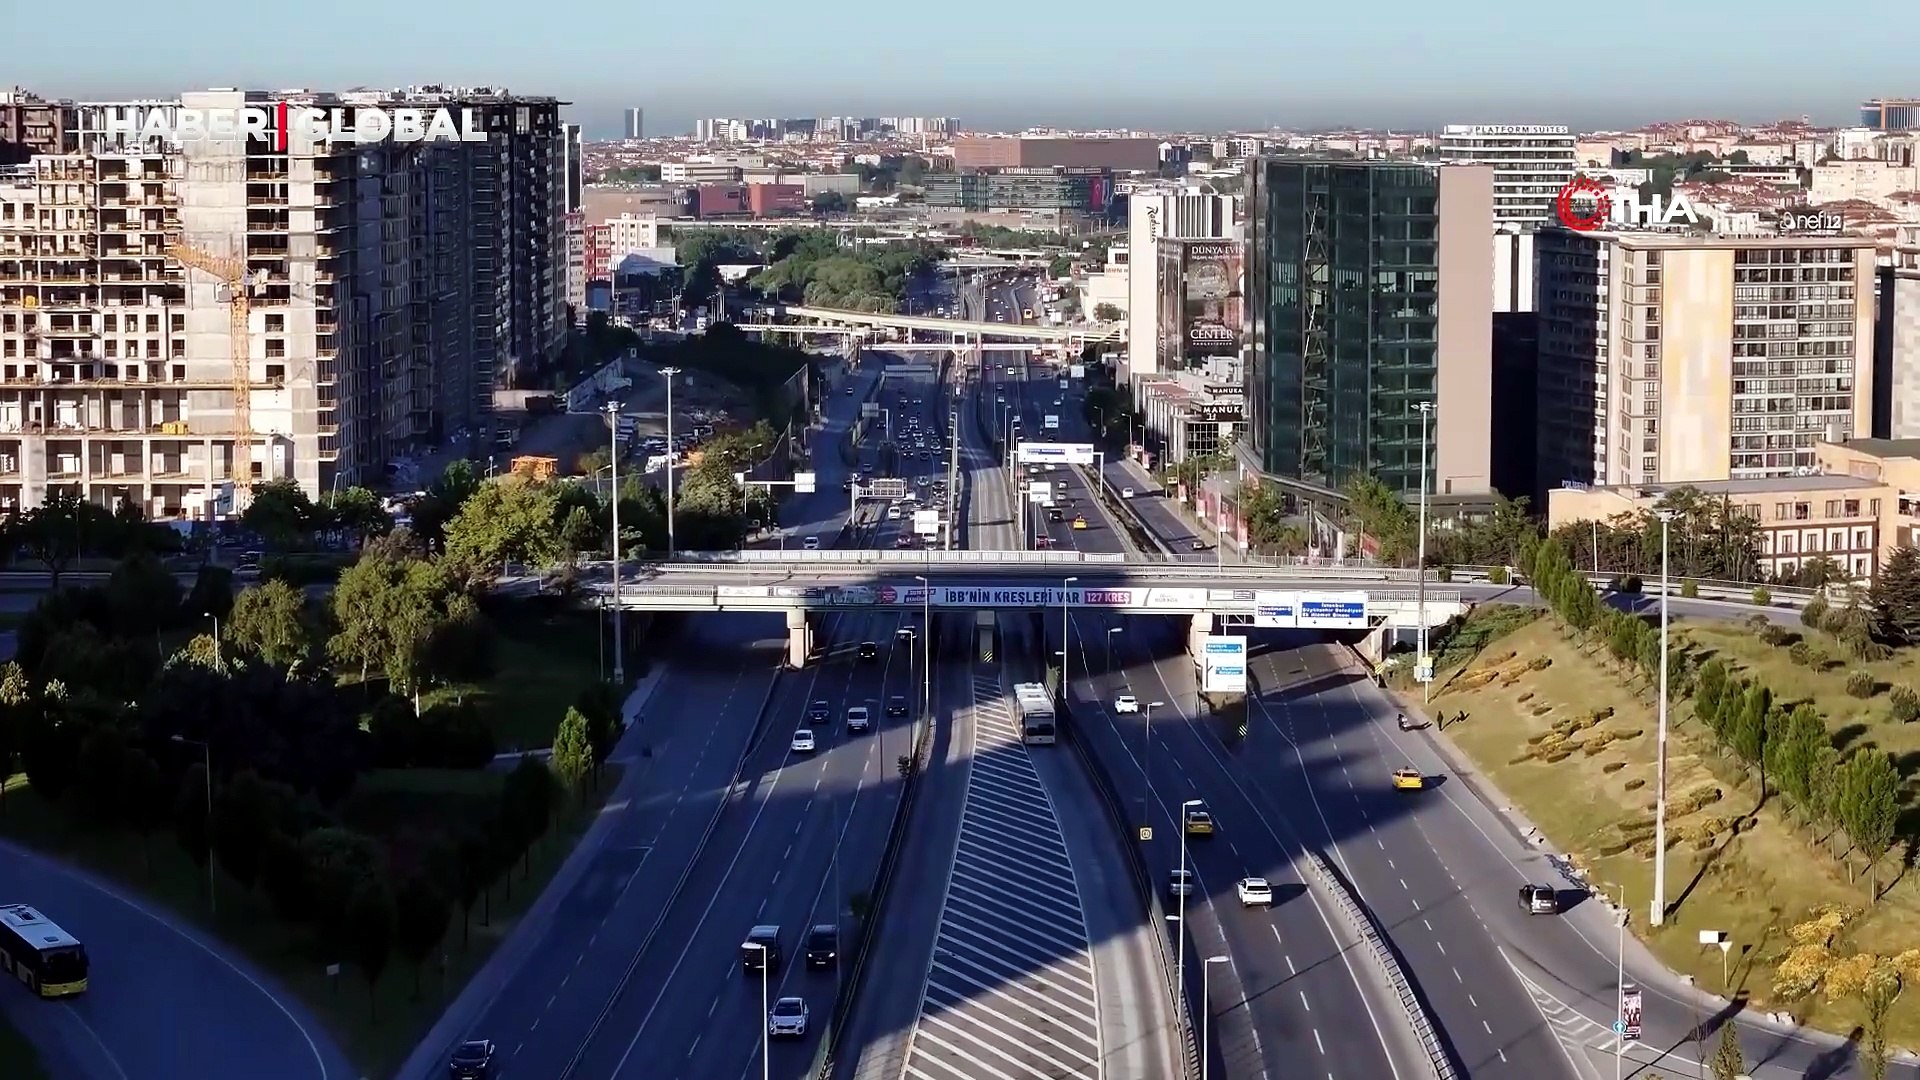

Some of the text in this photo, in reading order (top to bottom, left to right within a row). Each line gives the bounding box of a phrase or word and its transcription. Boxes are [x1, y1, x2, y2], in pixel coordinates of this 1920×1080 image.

[1191, 245, 1223, 254] DÜNYA
[1190, 329, 1234, 339] CENTER
[945, 588, 990, 603] İBB'NİN
[994, 588, 1052, 605] KREŞLERİ
[1056, 590, 1080, 604] VAR
[1086, 592, 1130, 604] 127 KREŞ
